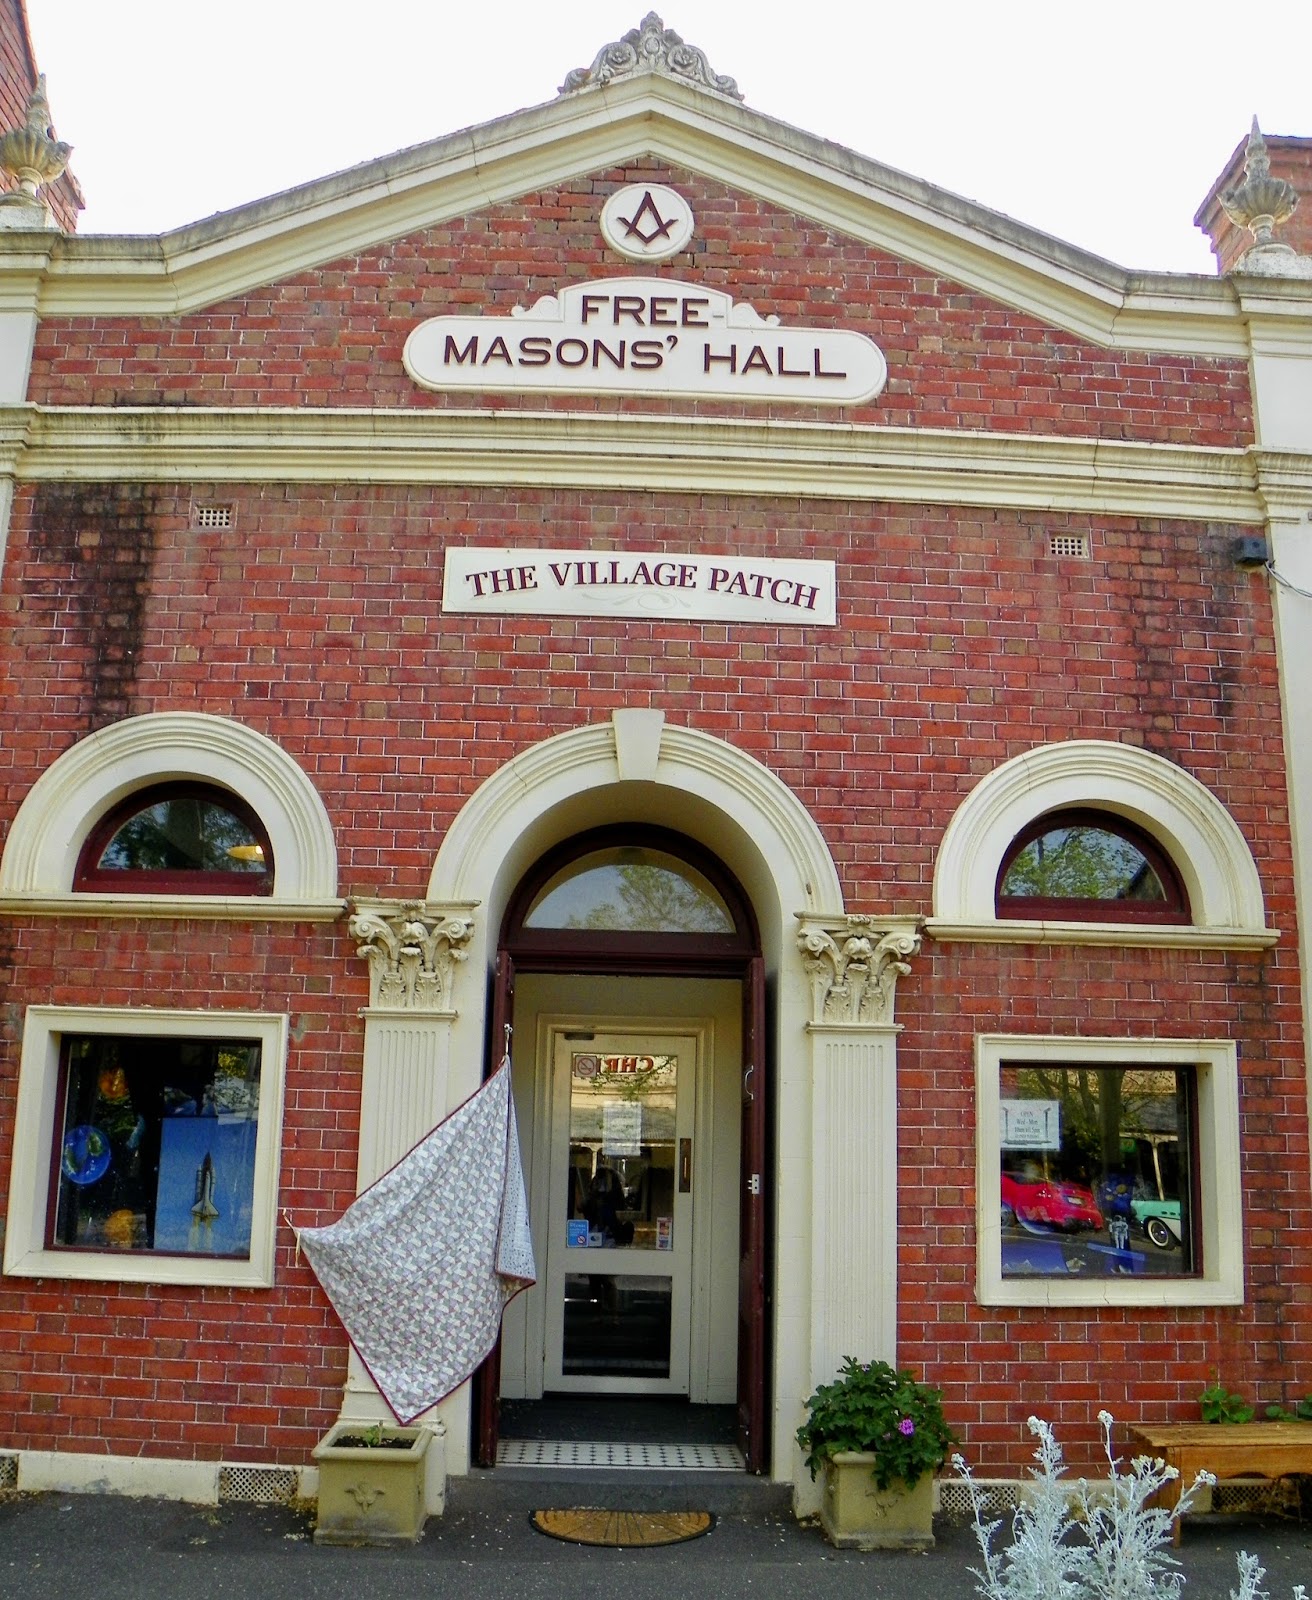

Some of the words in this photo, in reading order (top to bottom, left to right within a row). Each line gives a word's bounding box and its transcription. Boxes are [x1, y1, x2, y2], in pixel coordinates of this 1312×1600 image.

[443, 334, 678, 369] MASONS'
[703, 343, 847, 378] HALL
[465, 565, 538, 598] THE
[547, 561, 698, 589] VILLAGE
[707, 567, 820, 611] PATCH
